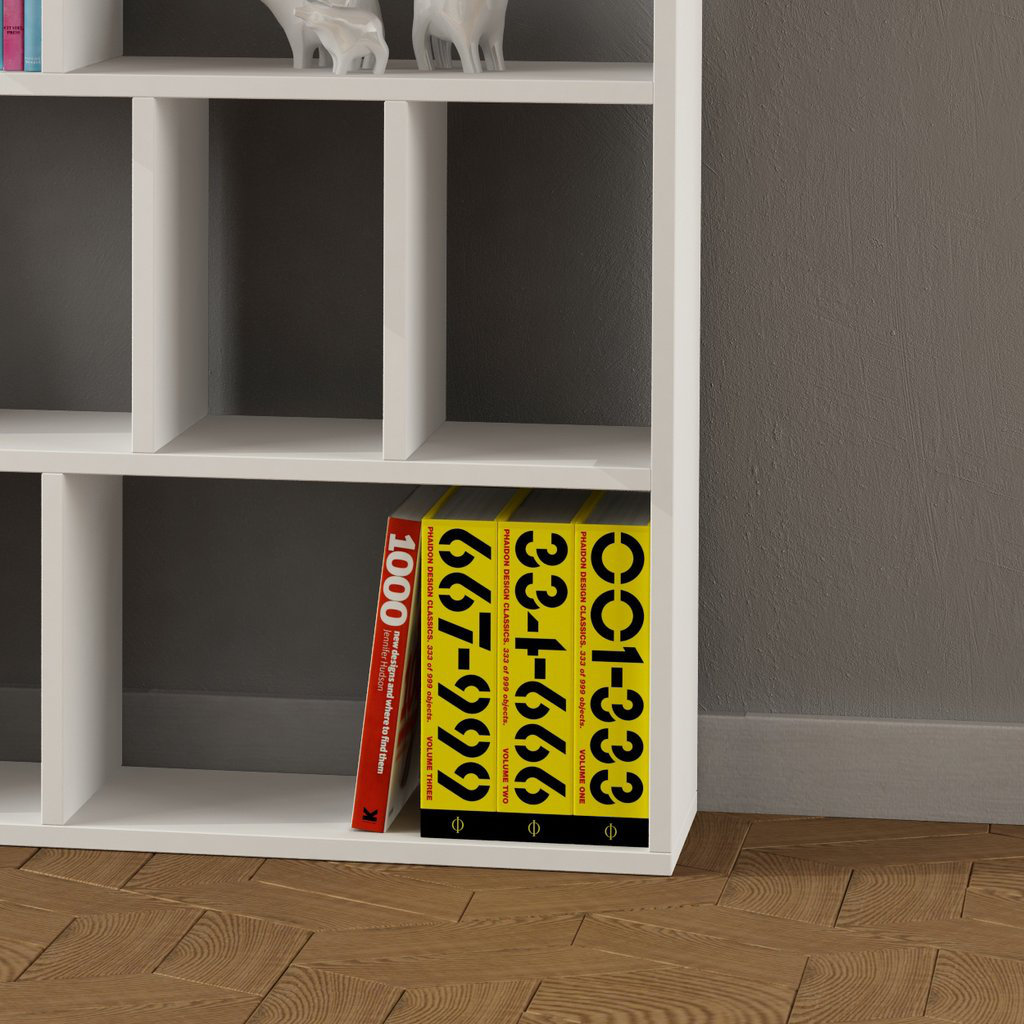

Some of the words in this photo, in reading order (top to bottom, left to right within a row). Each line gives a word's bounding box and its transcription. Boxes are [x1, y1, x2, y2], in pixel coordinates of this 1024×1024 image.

[380, 533, 416, 626] 1000
[380, 629, 391, 660] Jennifer
[393, 631, 401, 648] new
[377, 661, 388, 692] Hudson
[388, 650, 400, 682] designs
[427, 663, 433, 671] of
[438, 528, 492, 802] 667-999
[503, 666, 509, 674] of
[514, 531, 568, 805] 334-666
[580, 668, 586, 677] of
[590, 532, 644, 805] 001-333
[386, 683, 394, 698] and
[383, 700, 392, 725] where
[425, 691, 433, 723] objects.
[578, 697, 586, 728] objects.
[380, 736, 389, 752] find
[382, 726, 389, 735] to
[377, 753, 386, 774] them
